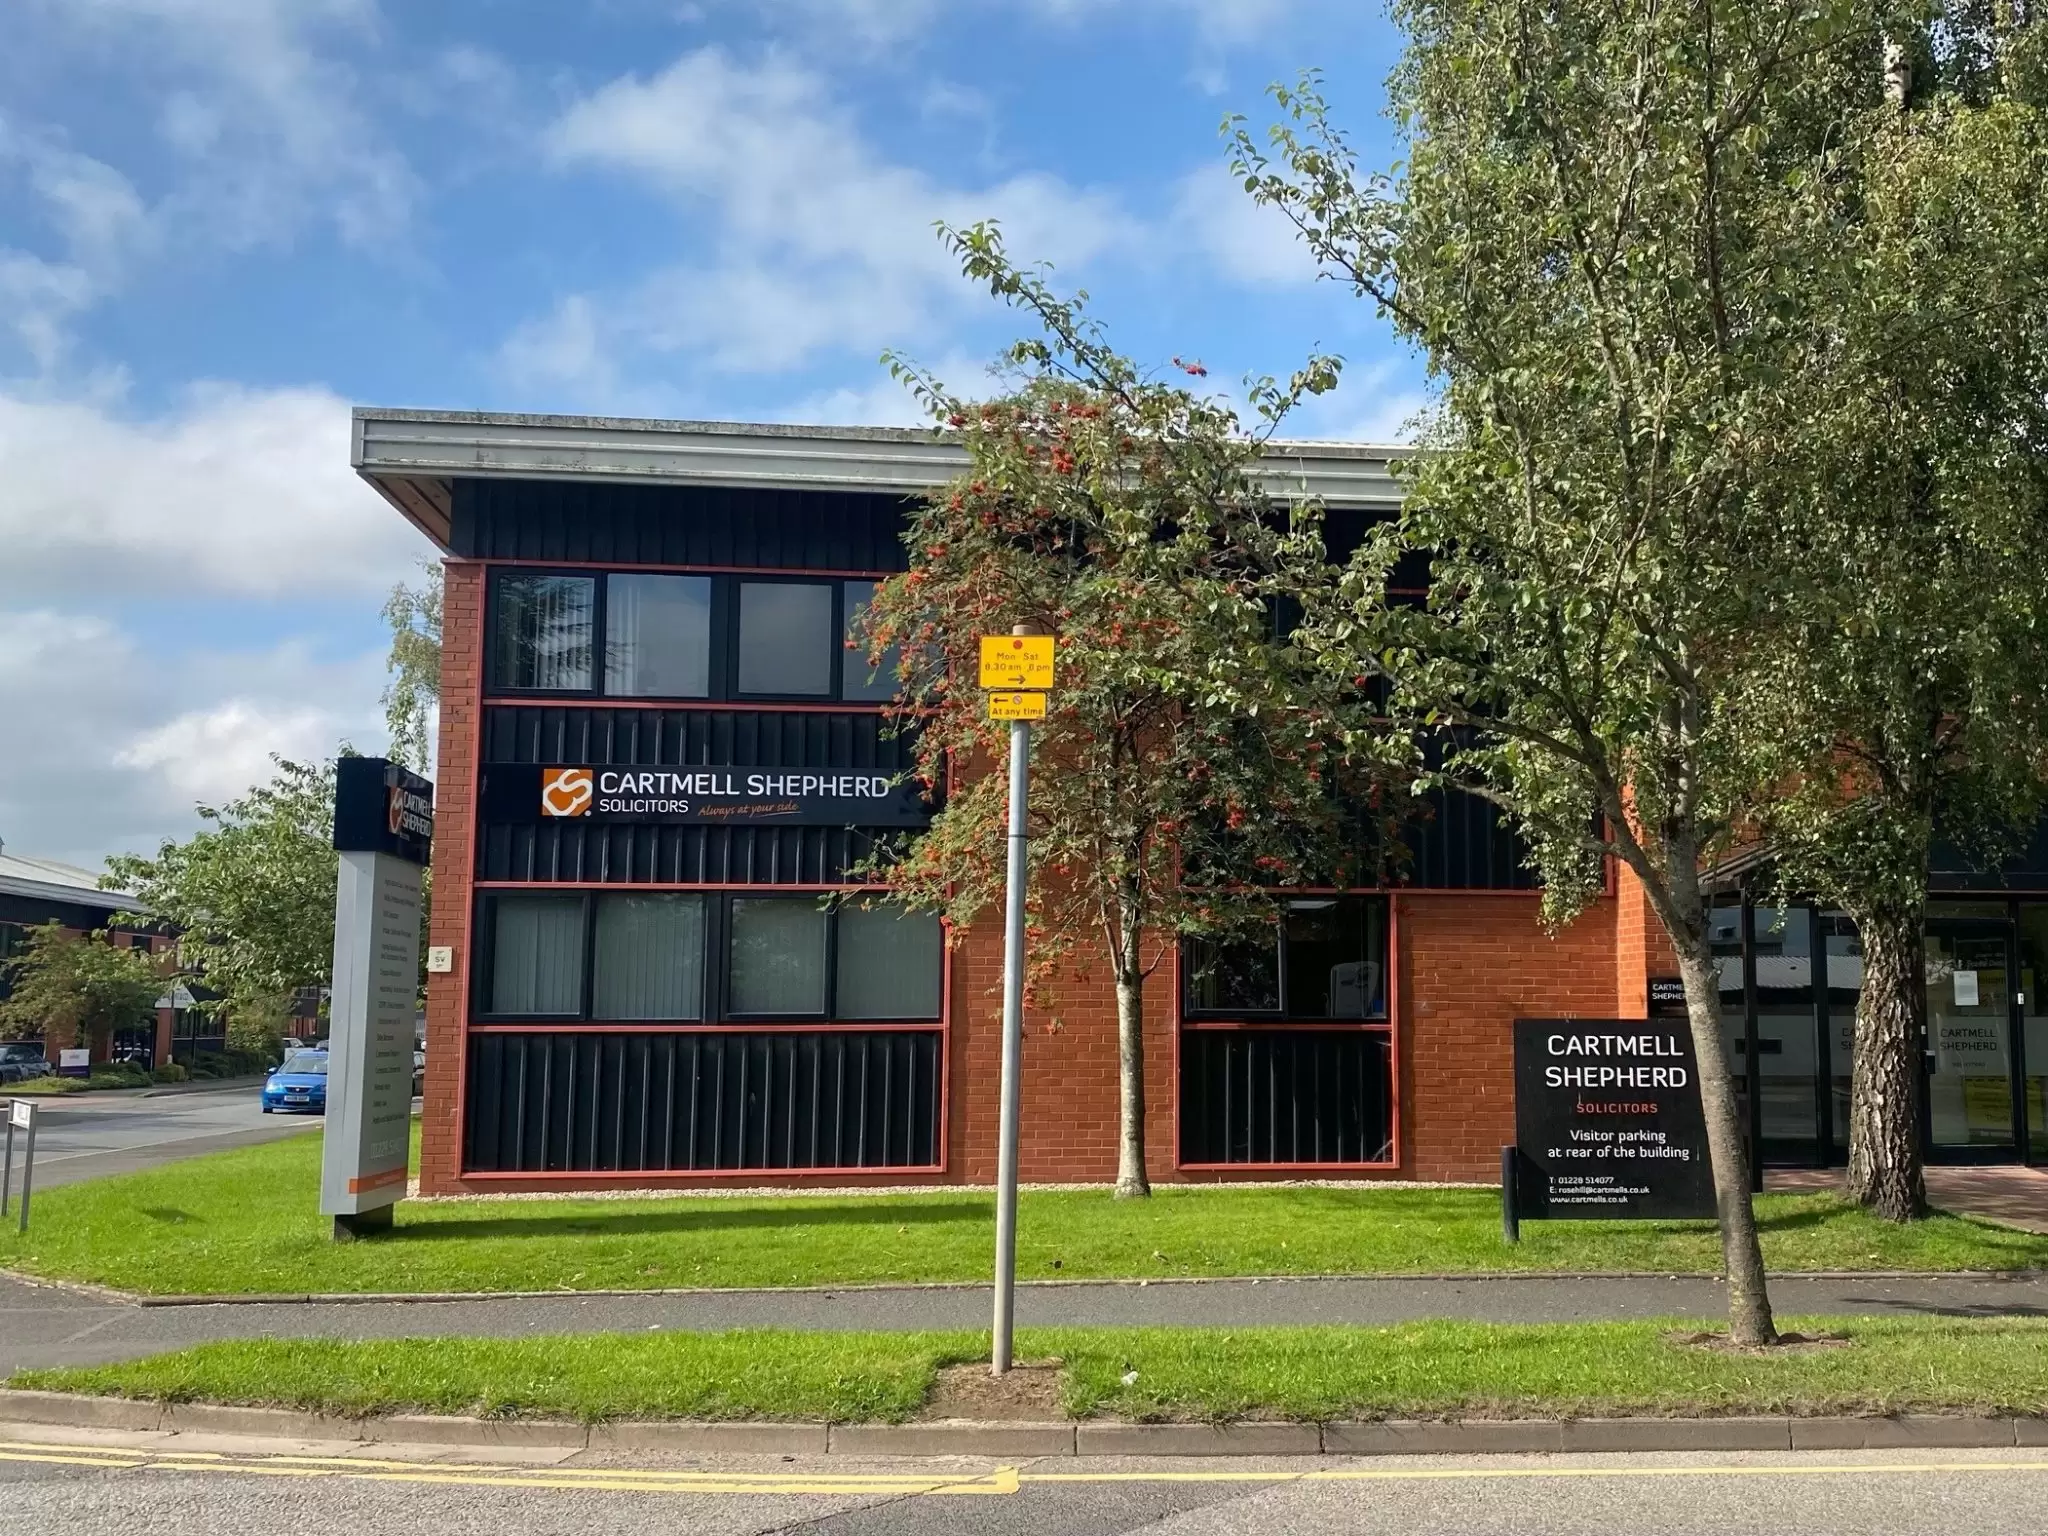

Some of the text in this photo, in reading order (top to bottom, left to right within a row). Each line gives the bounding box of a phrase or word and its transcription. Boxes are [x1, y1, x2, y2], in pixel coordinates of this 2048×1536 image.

[996, 652, 1038, 661] Mon Sat
[1036, 664, 1051, 673] pm
[992, 707, 1044, 718] At any time
[599, 772, 891, 799] CARTMELL SHEPHERD
[403, 791, 432, 818] CARTMELL
[598, 798, 799, 820] SOLICITORS Always at your side
[402, 811, 432, 837] SHEPHERD
[1652, 983, 1685, 991] CARTME
[1940, 1028, 1997, 1038] CARTMELL
[1547, 1035, 1684, 1057] CARTMELL
[1939, 1041, 1998, 1051] SHEPHERD
[1545, 1066, 1688, 1088] SHEPHERD
[1576, 1103, 1659, 1114] SOLICITORS
[1569, 1129, 1667, 1145] Visitor parking
[1547, 1145, 1691, 1161] at rear of the building
[1558, 1176, 1584, 1184] 01228
[1585, 1176, 1615, 1184] 514077
[1549, 1186, 1557, 1194] E:
[1549, 1196, 1629, 1204] www.cartmells.co.uk
